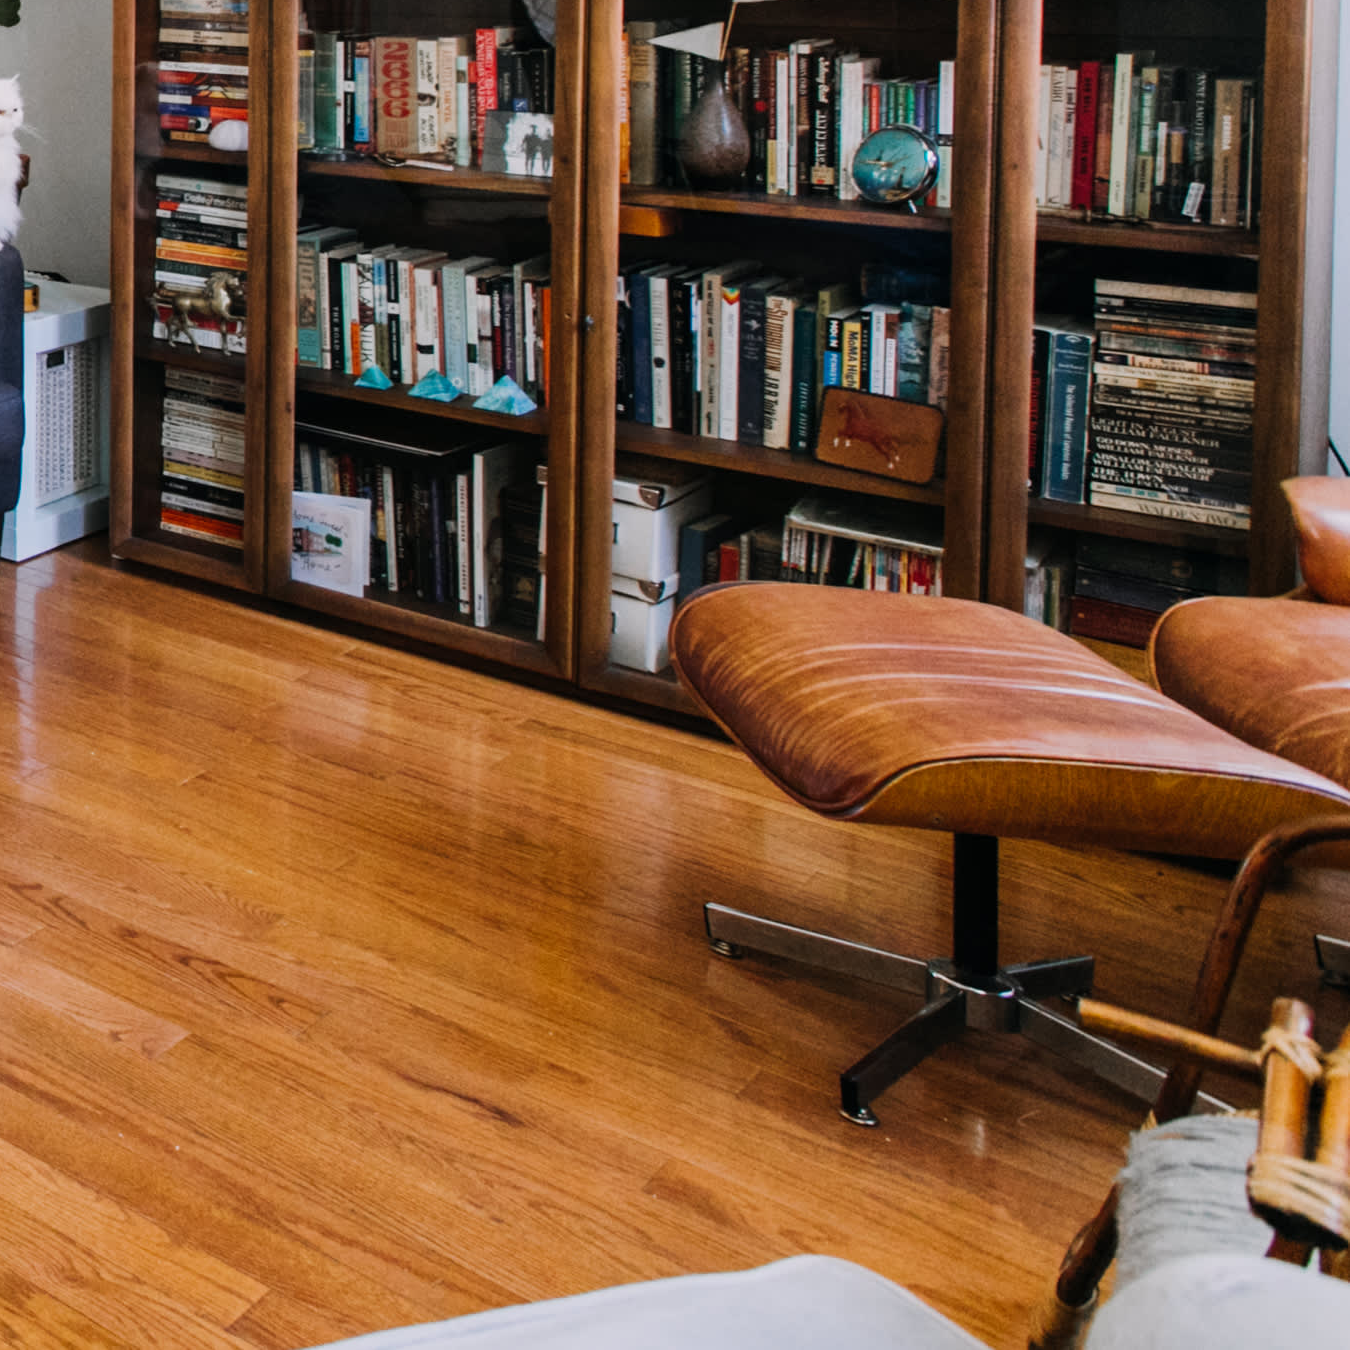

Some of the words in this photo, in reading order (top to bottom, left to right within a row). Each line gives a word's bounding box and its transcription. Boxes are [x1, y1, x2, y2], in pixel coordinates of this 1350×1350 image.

[382, 41, 410, 118] 2666
[847, 330, 860, 361] MoMA
[845, 364, 859, 389] High
[763, 398, 779, 430] Tolkien
[1091, 423, 1146, 437] WILLIAM
[1149, 430, 1220, 449] FAULKNER
[1096, 442, 1146, 456] WILLIAM
[1148, 449, 1209, 465] FAULKNER
[1092, 472, 1134, 484] WILLIAM
[1136, 478, 1189, 493] FAULKNER
[1093, 458, 1146, 472] WILLIAM
[1148, 465, 1210, 482] FAULKNER
[1139, 502, 1200, 520] WALDEN
[1205, 511, 1238, 527] TWO
